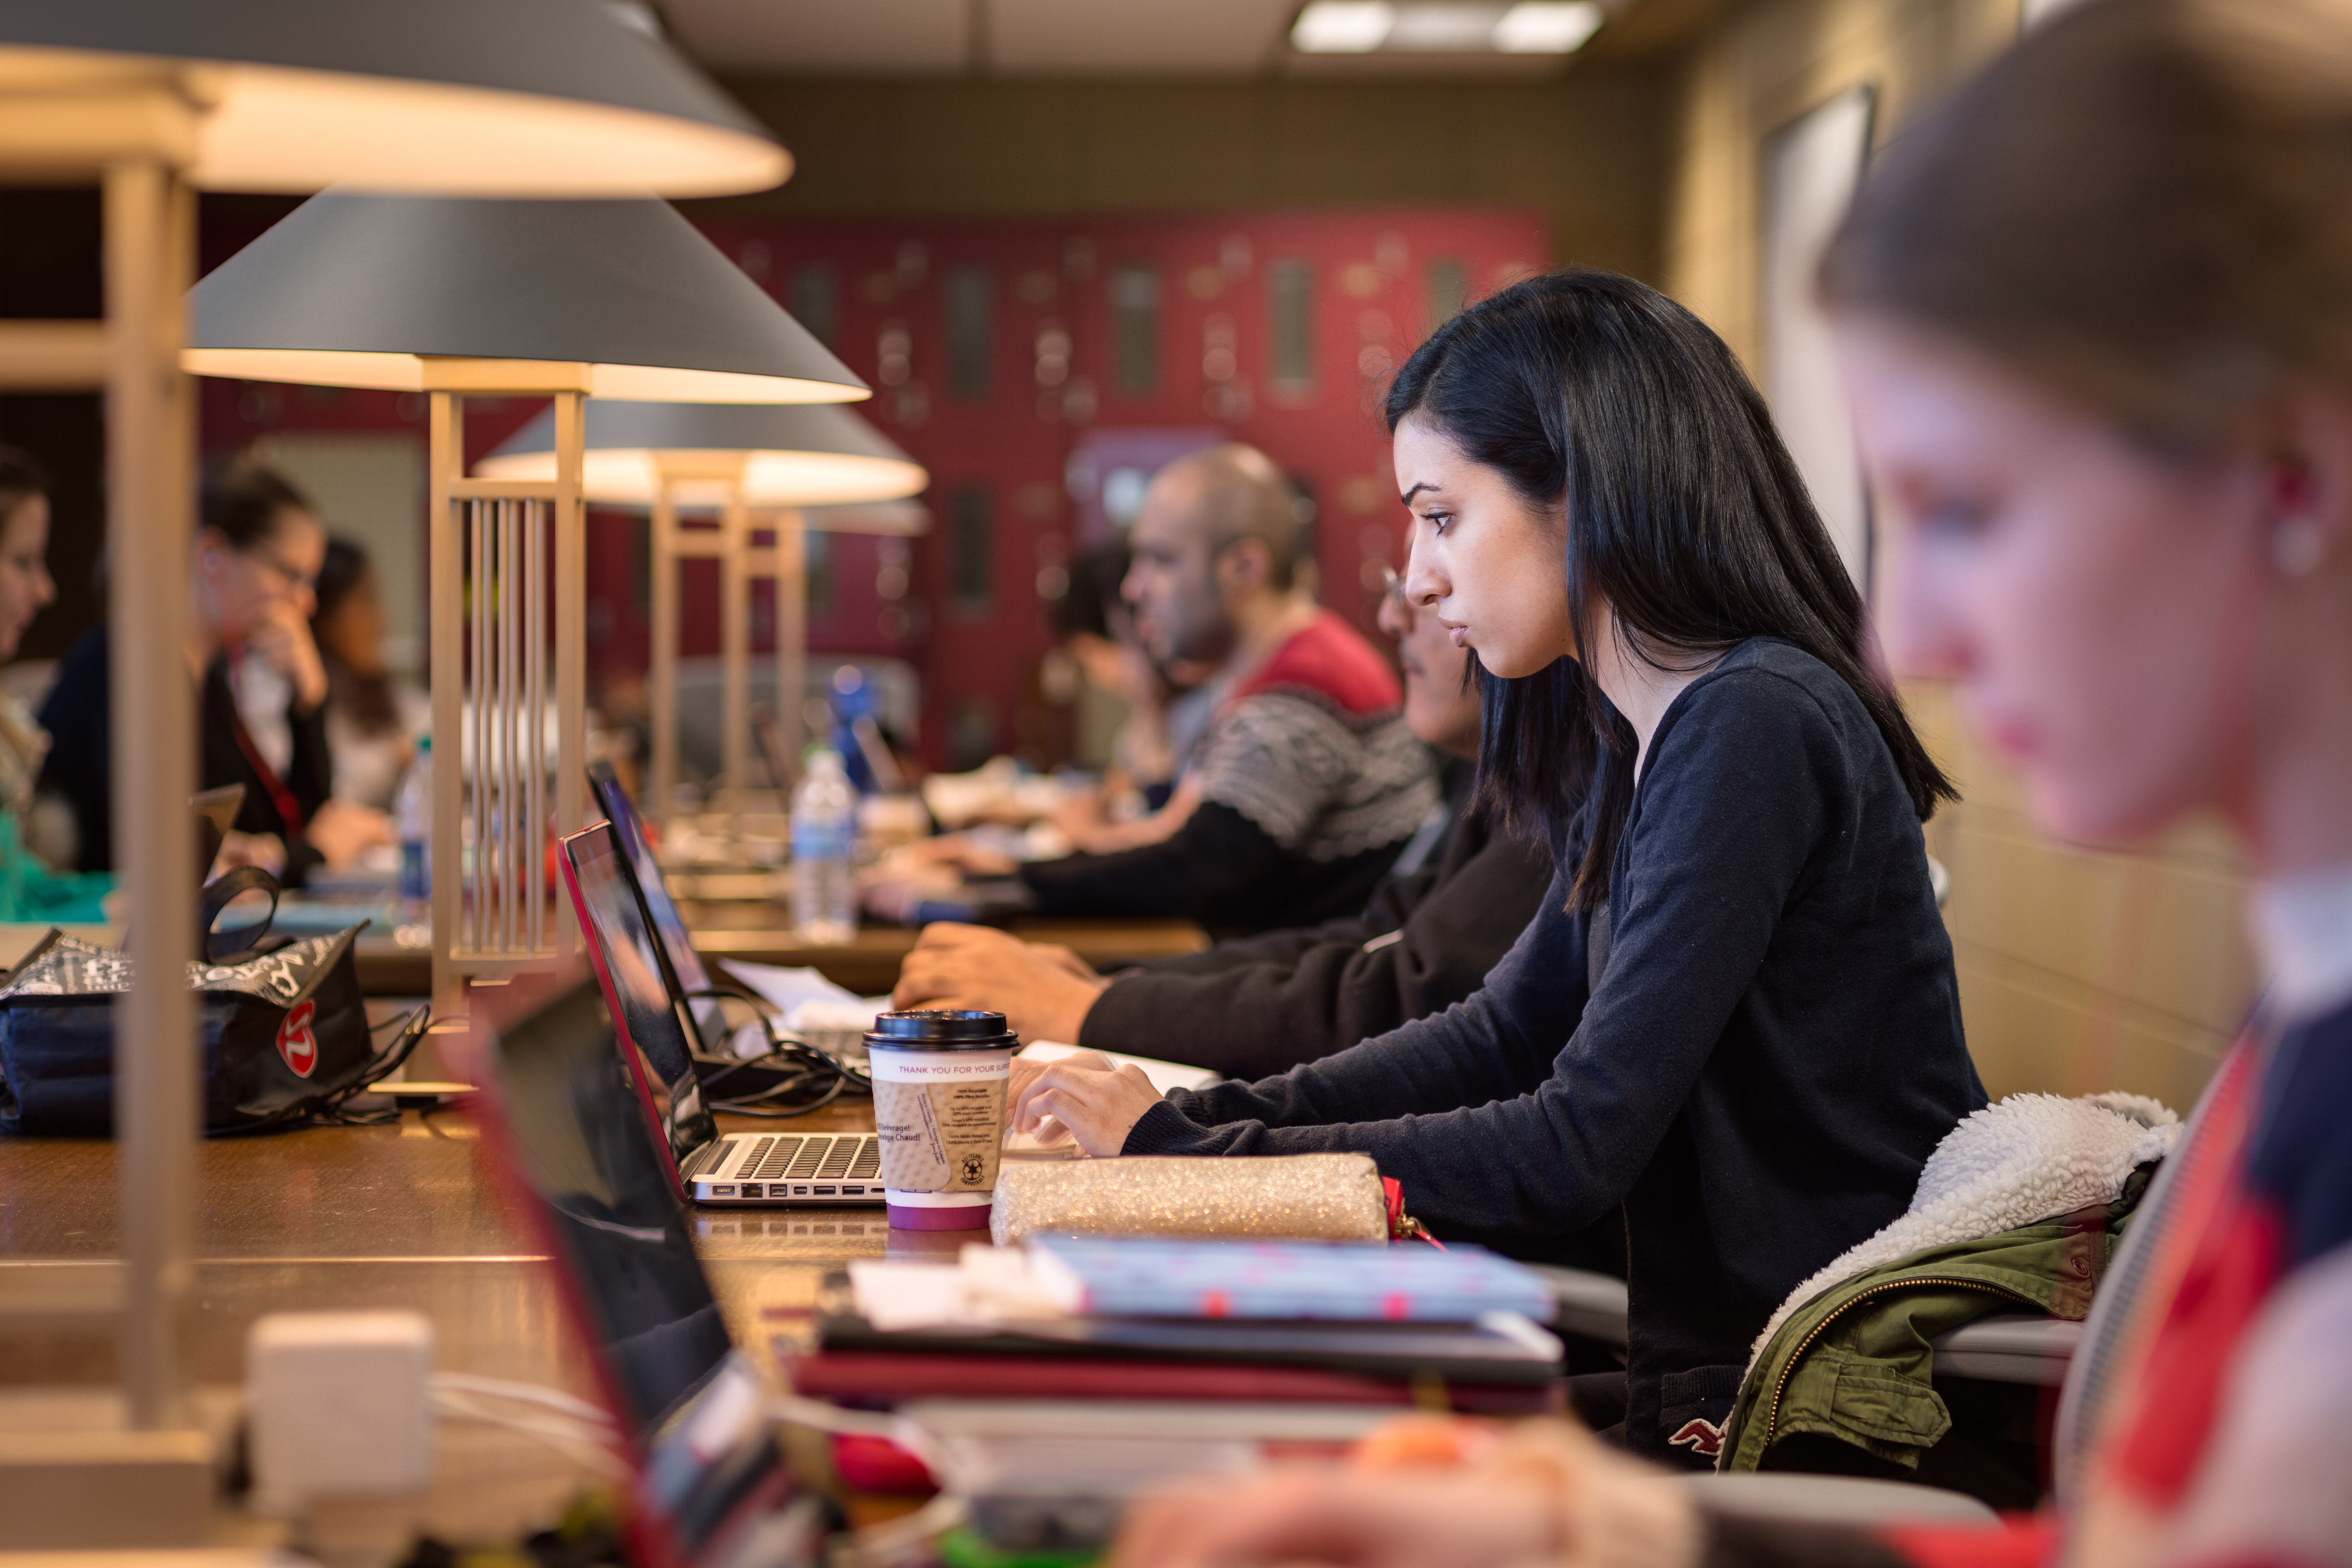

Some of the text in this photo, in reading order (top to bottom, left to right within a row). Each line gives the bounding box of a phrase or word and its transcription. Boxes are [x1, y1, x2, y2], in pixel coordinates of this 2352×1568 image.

[995, 1063, 1010, 1072] SUPPO
[882, 1124, 910, 1133] Beverage!
[961, 1153, 985, 1163] RECYCLABLE
[960, 1175, 985, 1186] COMPOSTABLE
